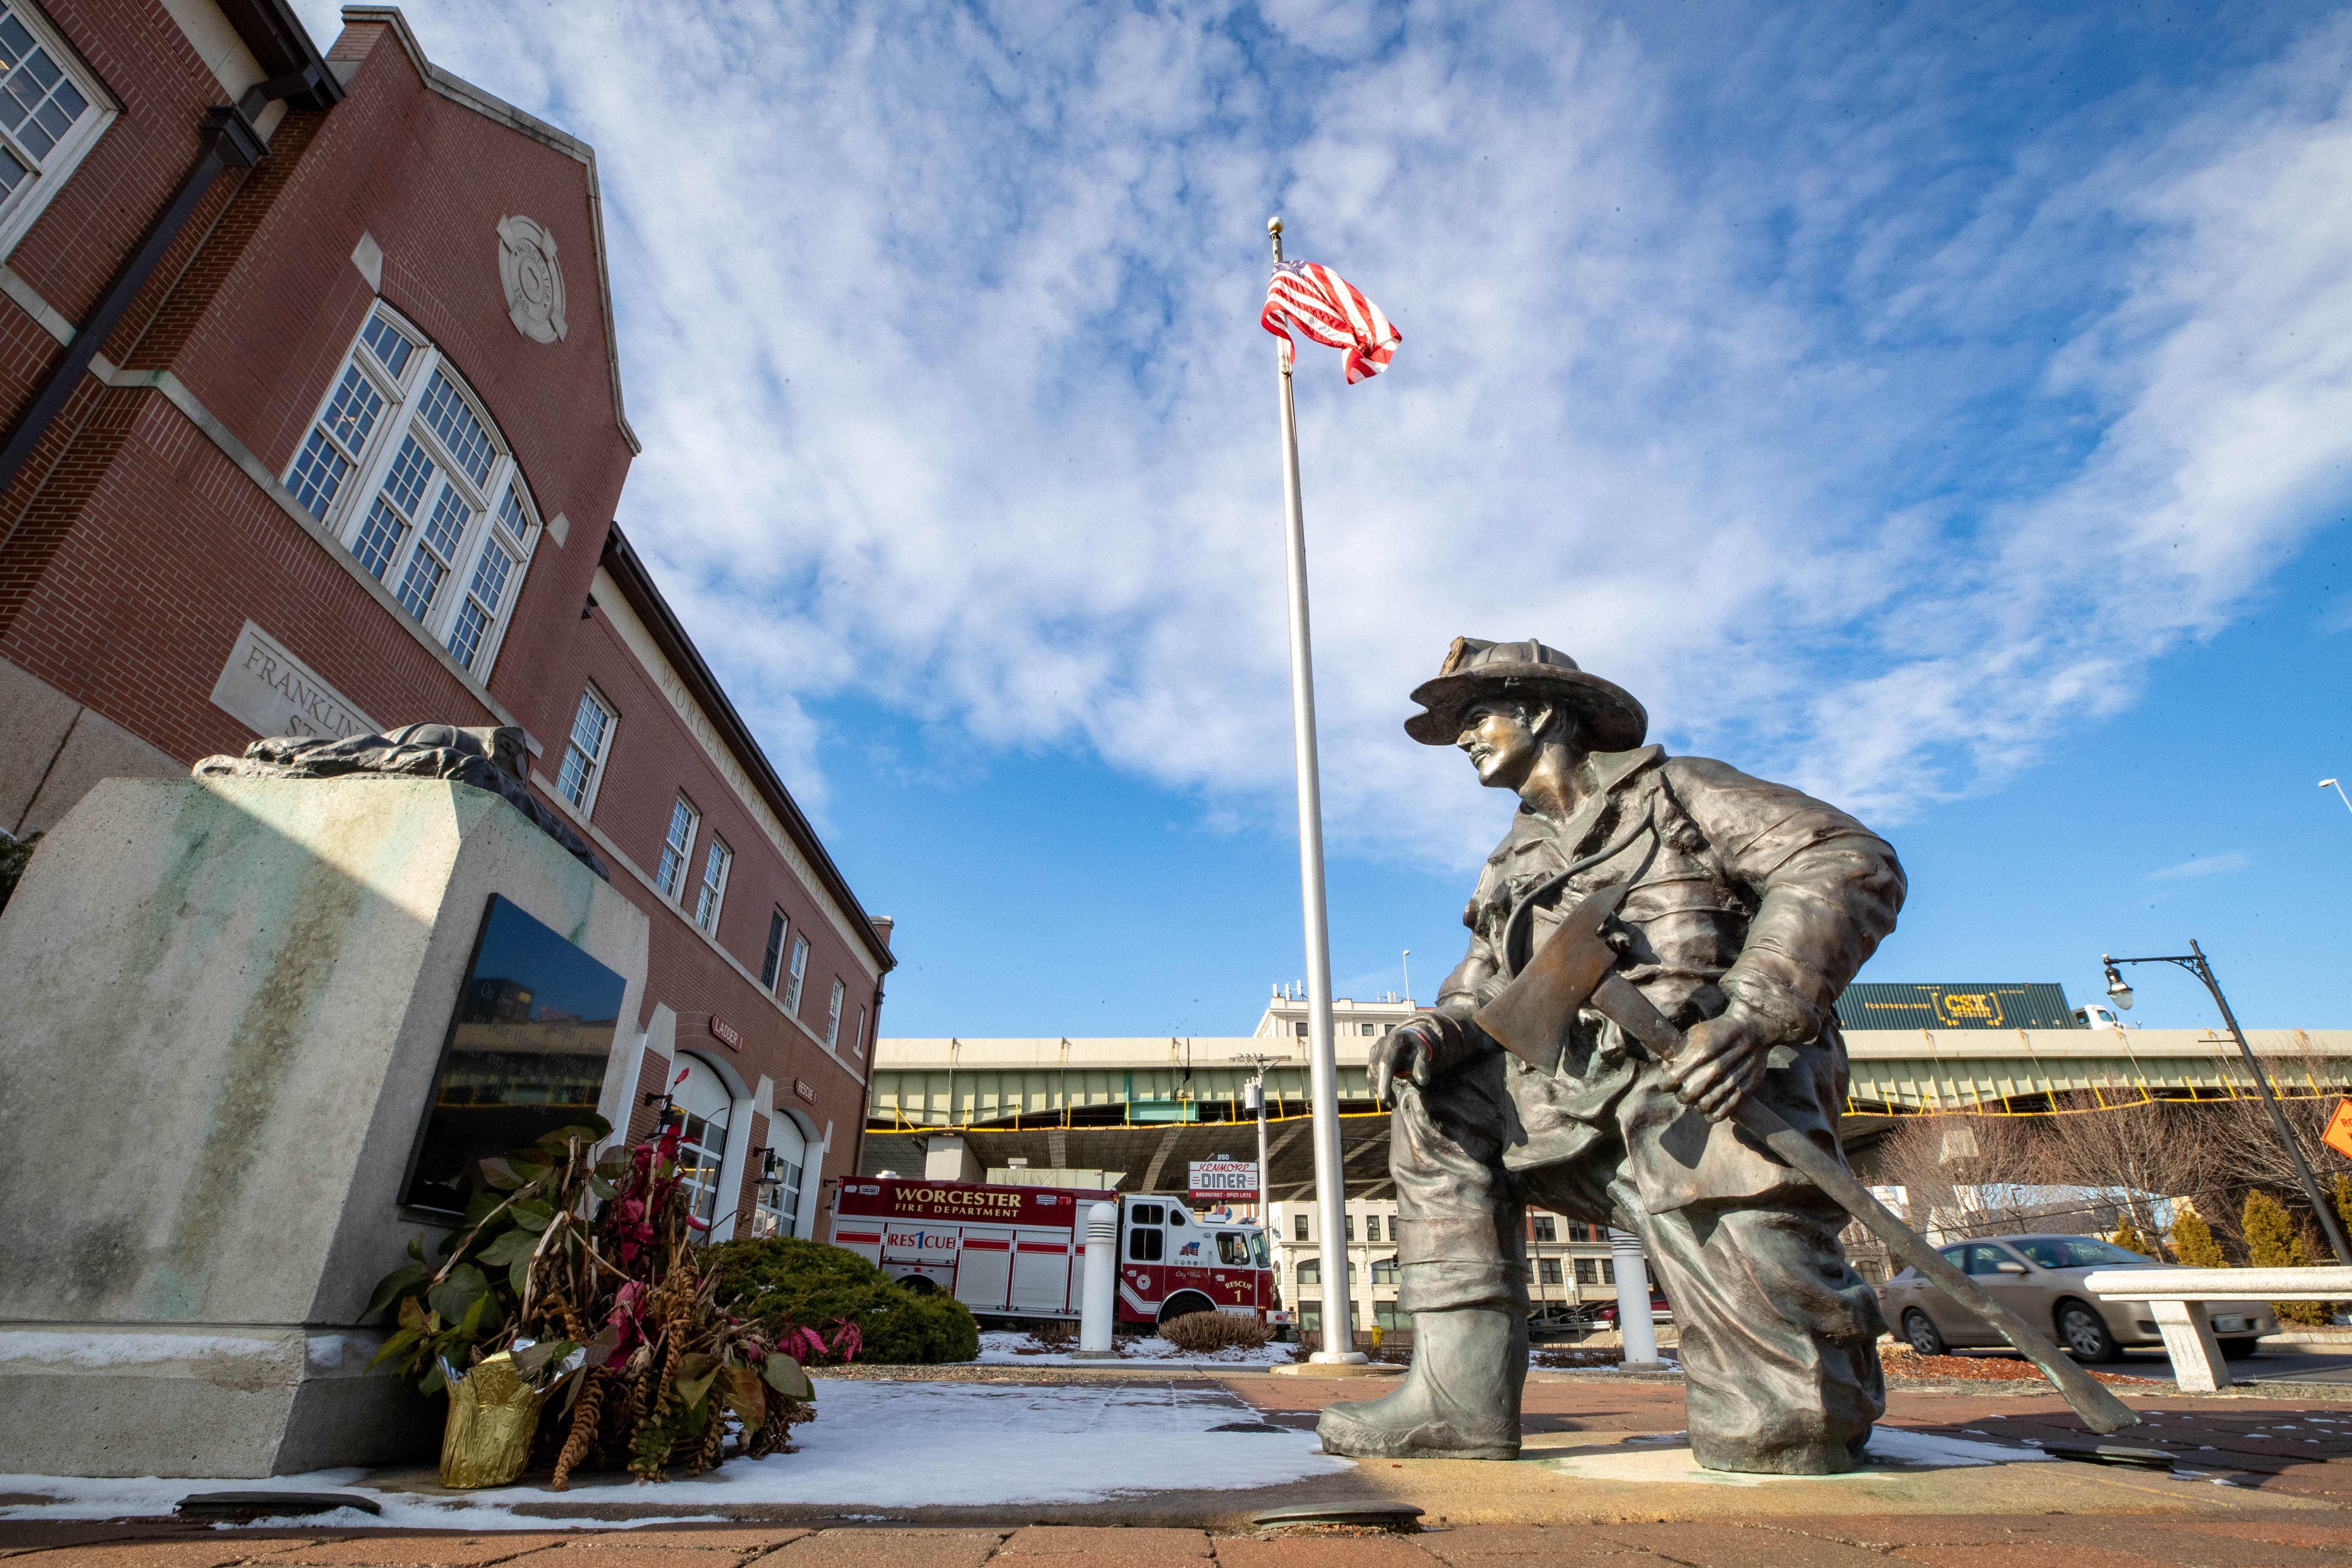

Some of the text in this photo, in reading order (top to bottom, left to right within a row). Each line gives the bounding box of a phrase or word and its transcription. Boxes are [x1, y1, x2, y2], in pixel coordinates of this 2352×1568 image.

[516, 244, 551, 301] WORCESTER
[243, 645, 360, 736] FRANKLIN
[481, 982, 495, 1000] On
[545, 1015, 577, 1041] December
[1945, 994, 1991, 1012] CSX
[715, 1018, 738, 1045] LADDER
[488, 1015, 510, 1038] brave
[548, 1044, 584, 1074] firefighters
[585, 1062, 598, 1078] lost
[487, 1049, 505, 1068] lives
[507, 1057, 517, 1072] in
[520, 1062, 533, 1079] the
[570, 1085, 585, 1101] Cold
[798, 1081, 813, 1100] RESCUE
[1199, 1163, 1250, 1172] KENMORE
[1202, 1173, 1246, 1188] DINER
[895, 1188, 1021, 1207] WORCESTER
[895, 1203, 1019, 1217] FIRE DEPARTMENT
[1176, 1271, 1186, 1279] City
[1225, 1280, 1253, 1290] RESCUE
[1234, 1290, 1241, 1302] 1
